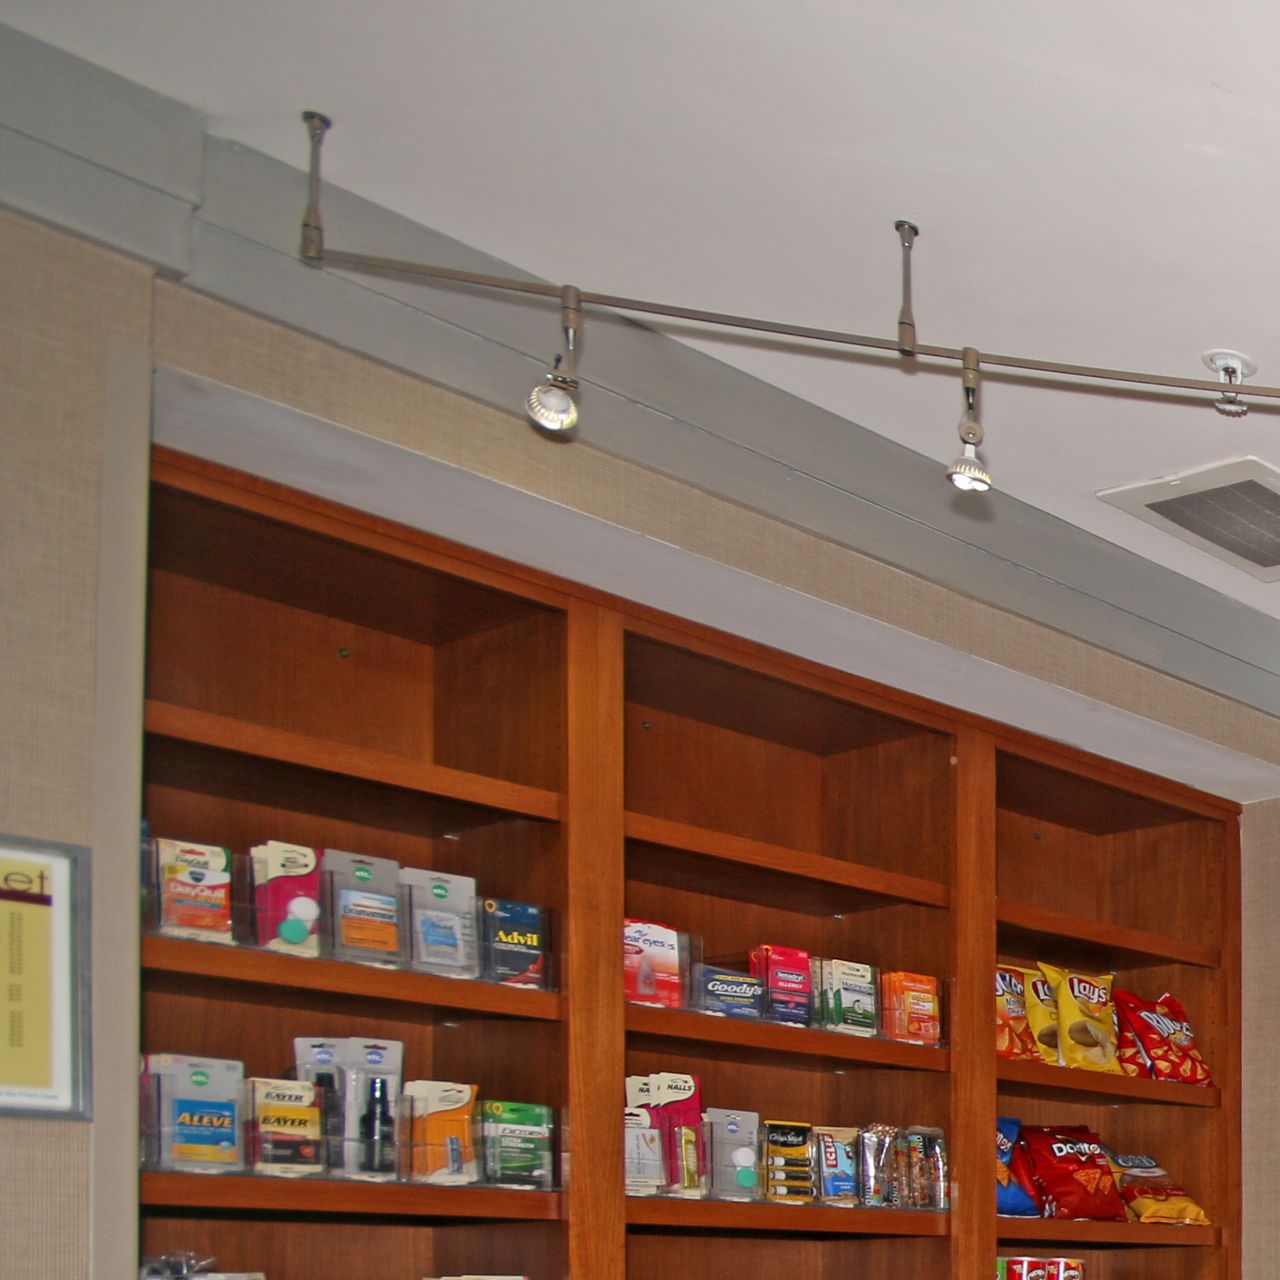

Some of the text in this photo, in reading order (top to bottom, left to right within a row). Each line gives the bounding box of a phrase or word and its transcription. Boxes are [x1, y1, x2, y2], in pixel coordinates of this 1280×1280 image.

[495, 929, 540, 947] Advil
[707, 981, 763, 996] Goody's
[667, 1083, 694, 1092] HALLS
[264, 1091, 304, 1102] BAYER
[176, 1111, 234, 1129] ALEVE
[261, 1115, 309, 1128] BAYER
[1052, 1141, 1103, 1158] Dorito
